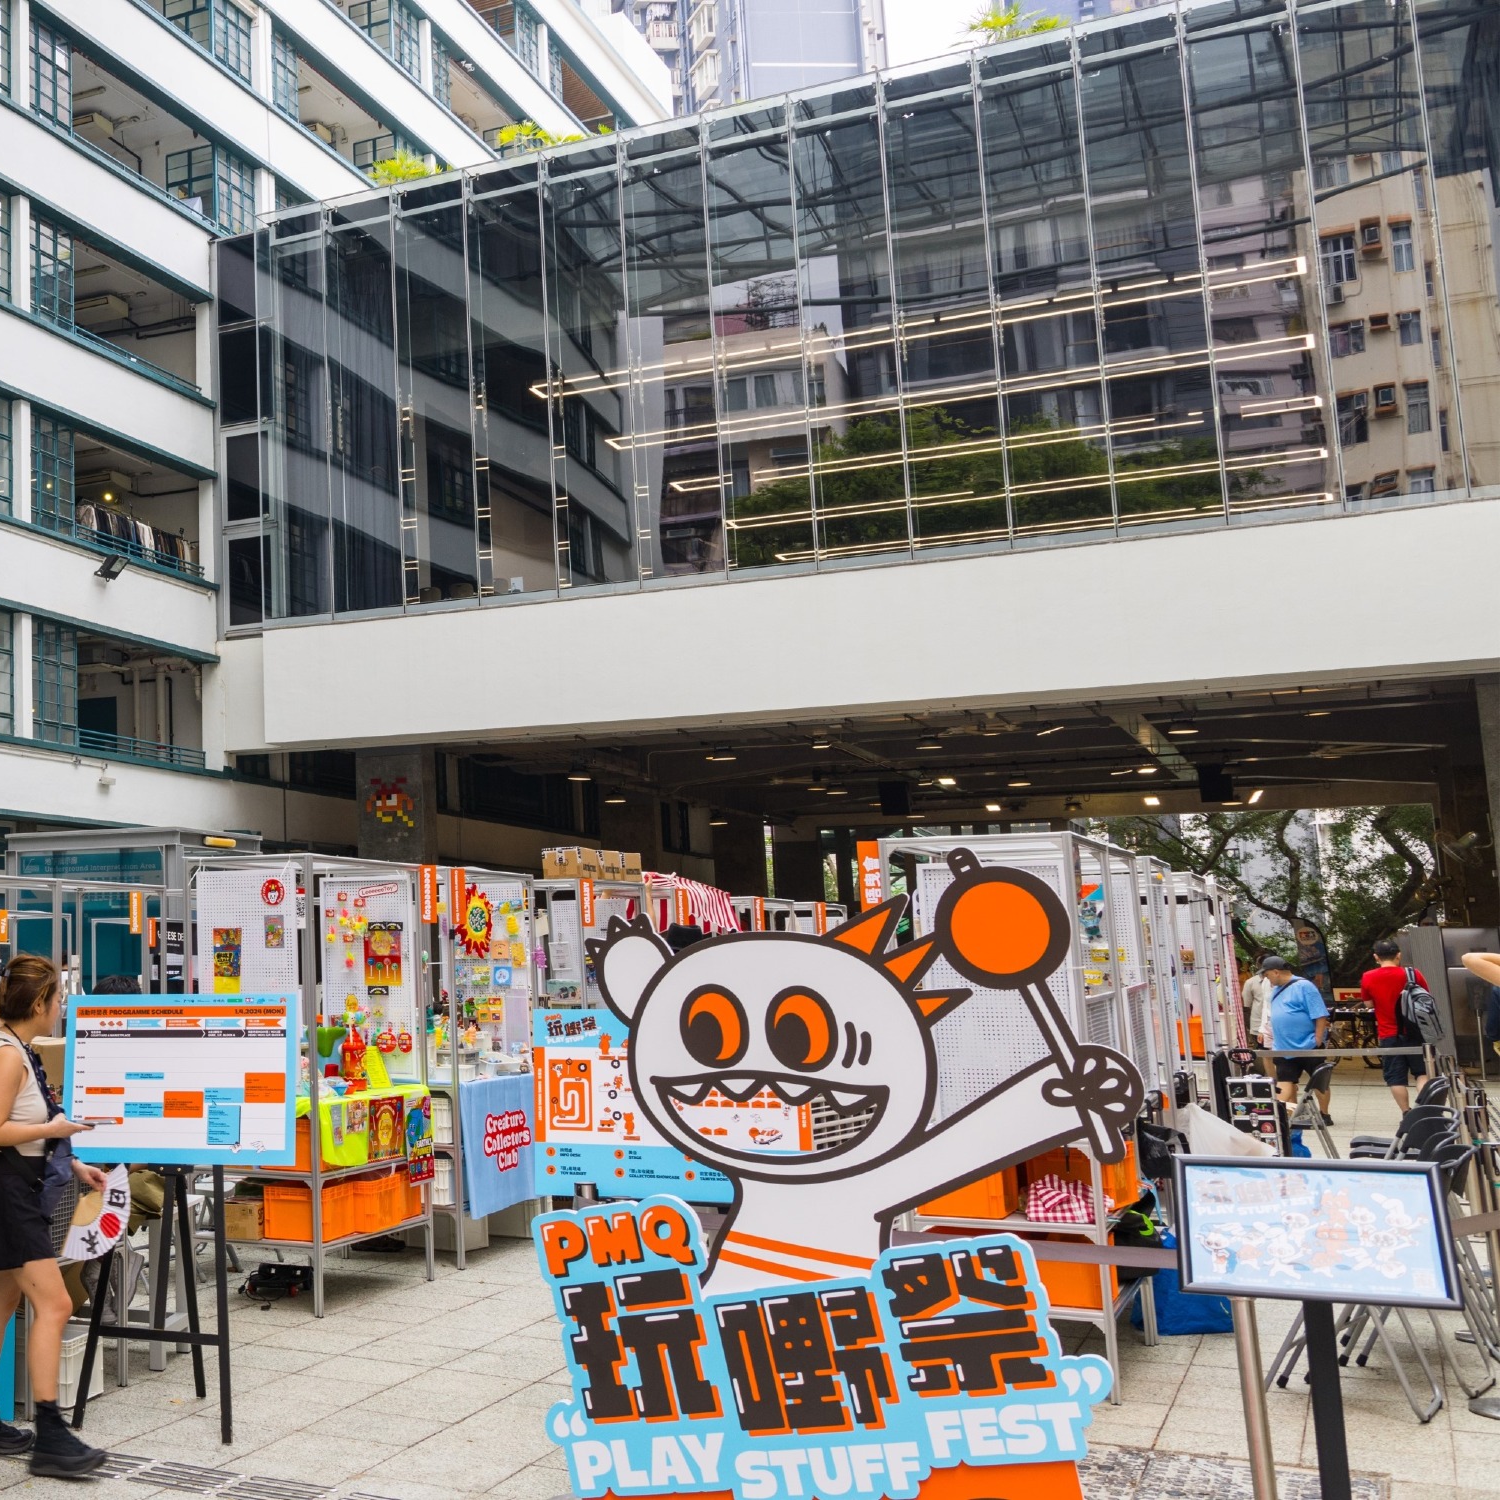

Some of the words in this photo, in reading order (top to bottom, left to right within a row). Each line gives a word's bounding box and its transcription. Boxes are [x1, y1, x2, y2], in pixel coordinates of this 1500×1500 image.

[45, 864, 88, 874] Underground
[90, 863, 138, 872] Interpretation
[140, 862, 156, 870] Area
[486, 1113, 524, 1134] Creature
[484, 1130, 530, 1154] Collectors
[498, 1149, 518, 1169] Club
[543, 1204, 695, 1278] PMQ
[560, 1245, 1058, 1436] 玩嘢祭
[734, 1441, 922, 1500] STUFF
